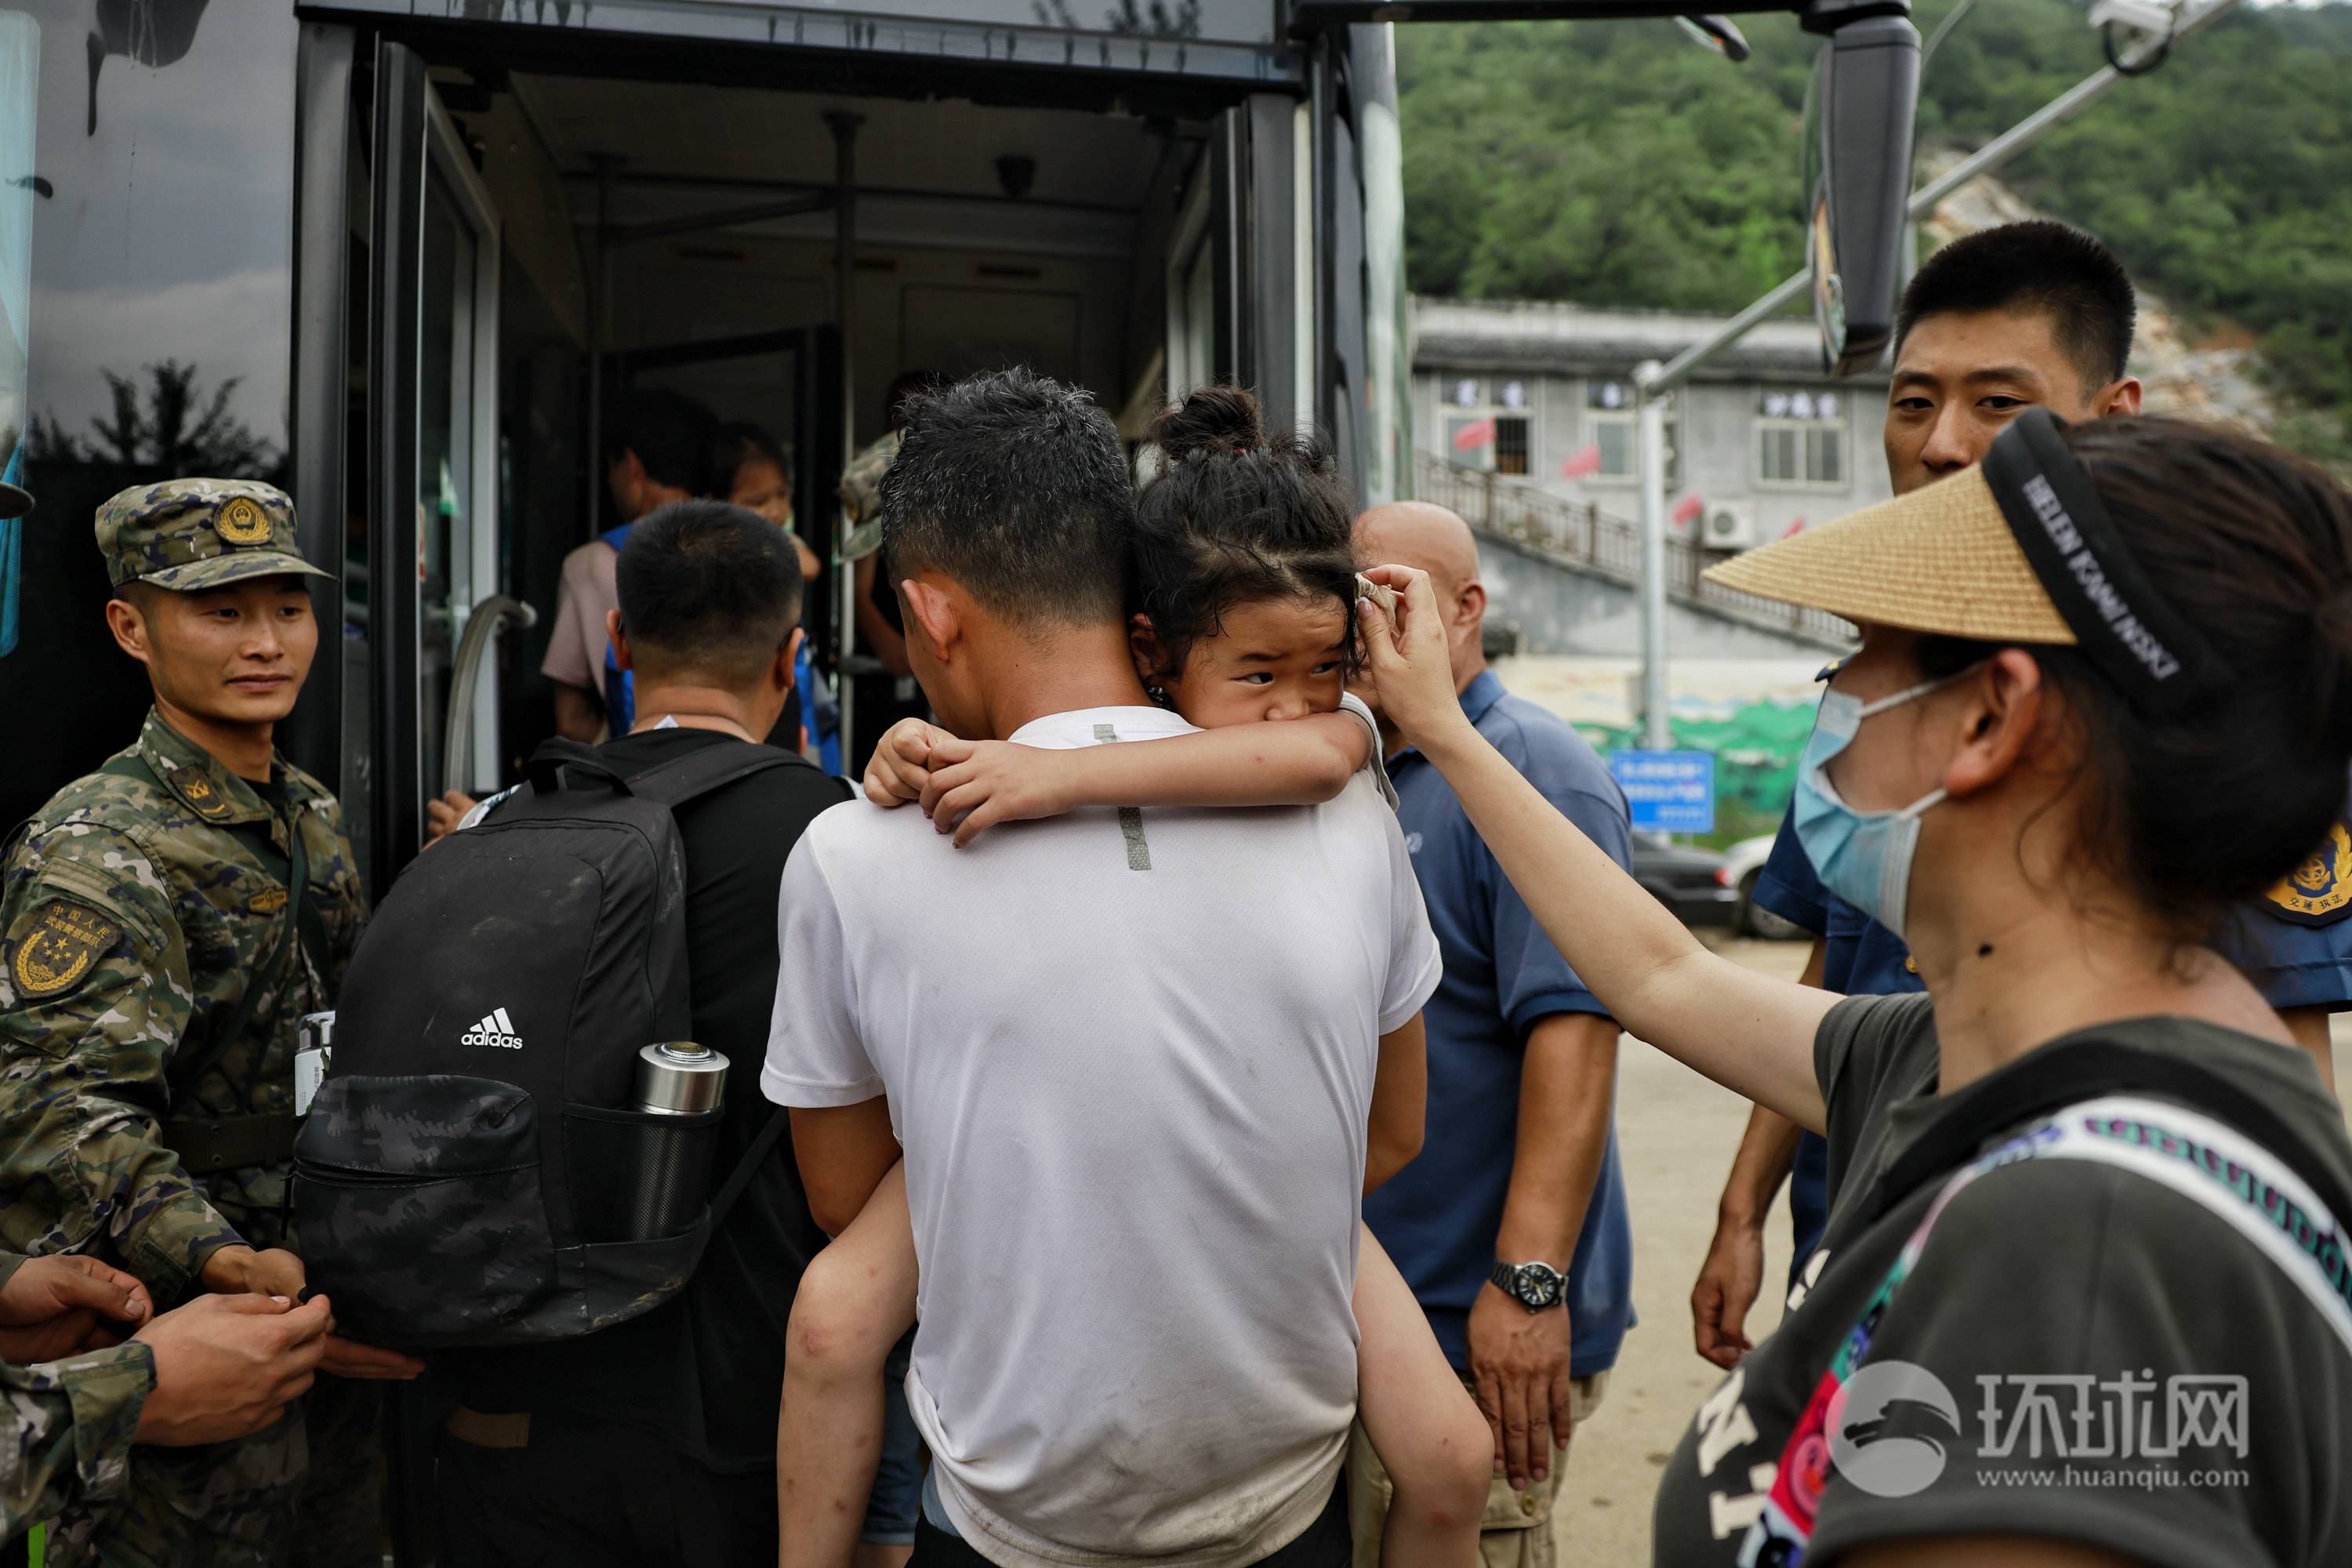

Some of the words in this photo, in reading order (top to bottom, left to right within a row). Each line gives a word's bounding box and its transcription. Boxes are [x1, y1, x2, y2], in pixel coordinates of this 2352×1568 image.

[2289, 894, 2343, 910] 交通执法
[53, 904, 110, 938] 中国人民
[461, 1031, 523, 1049] adidas
